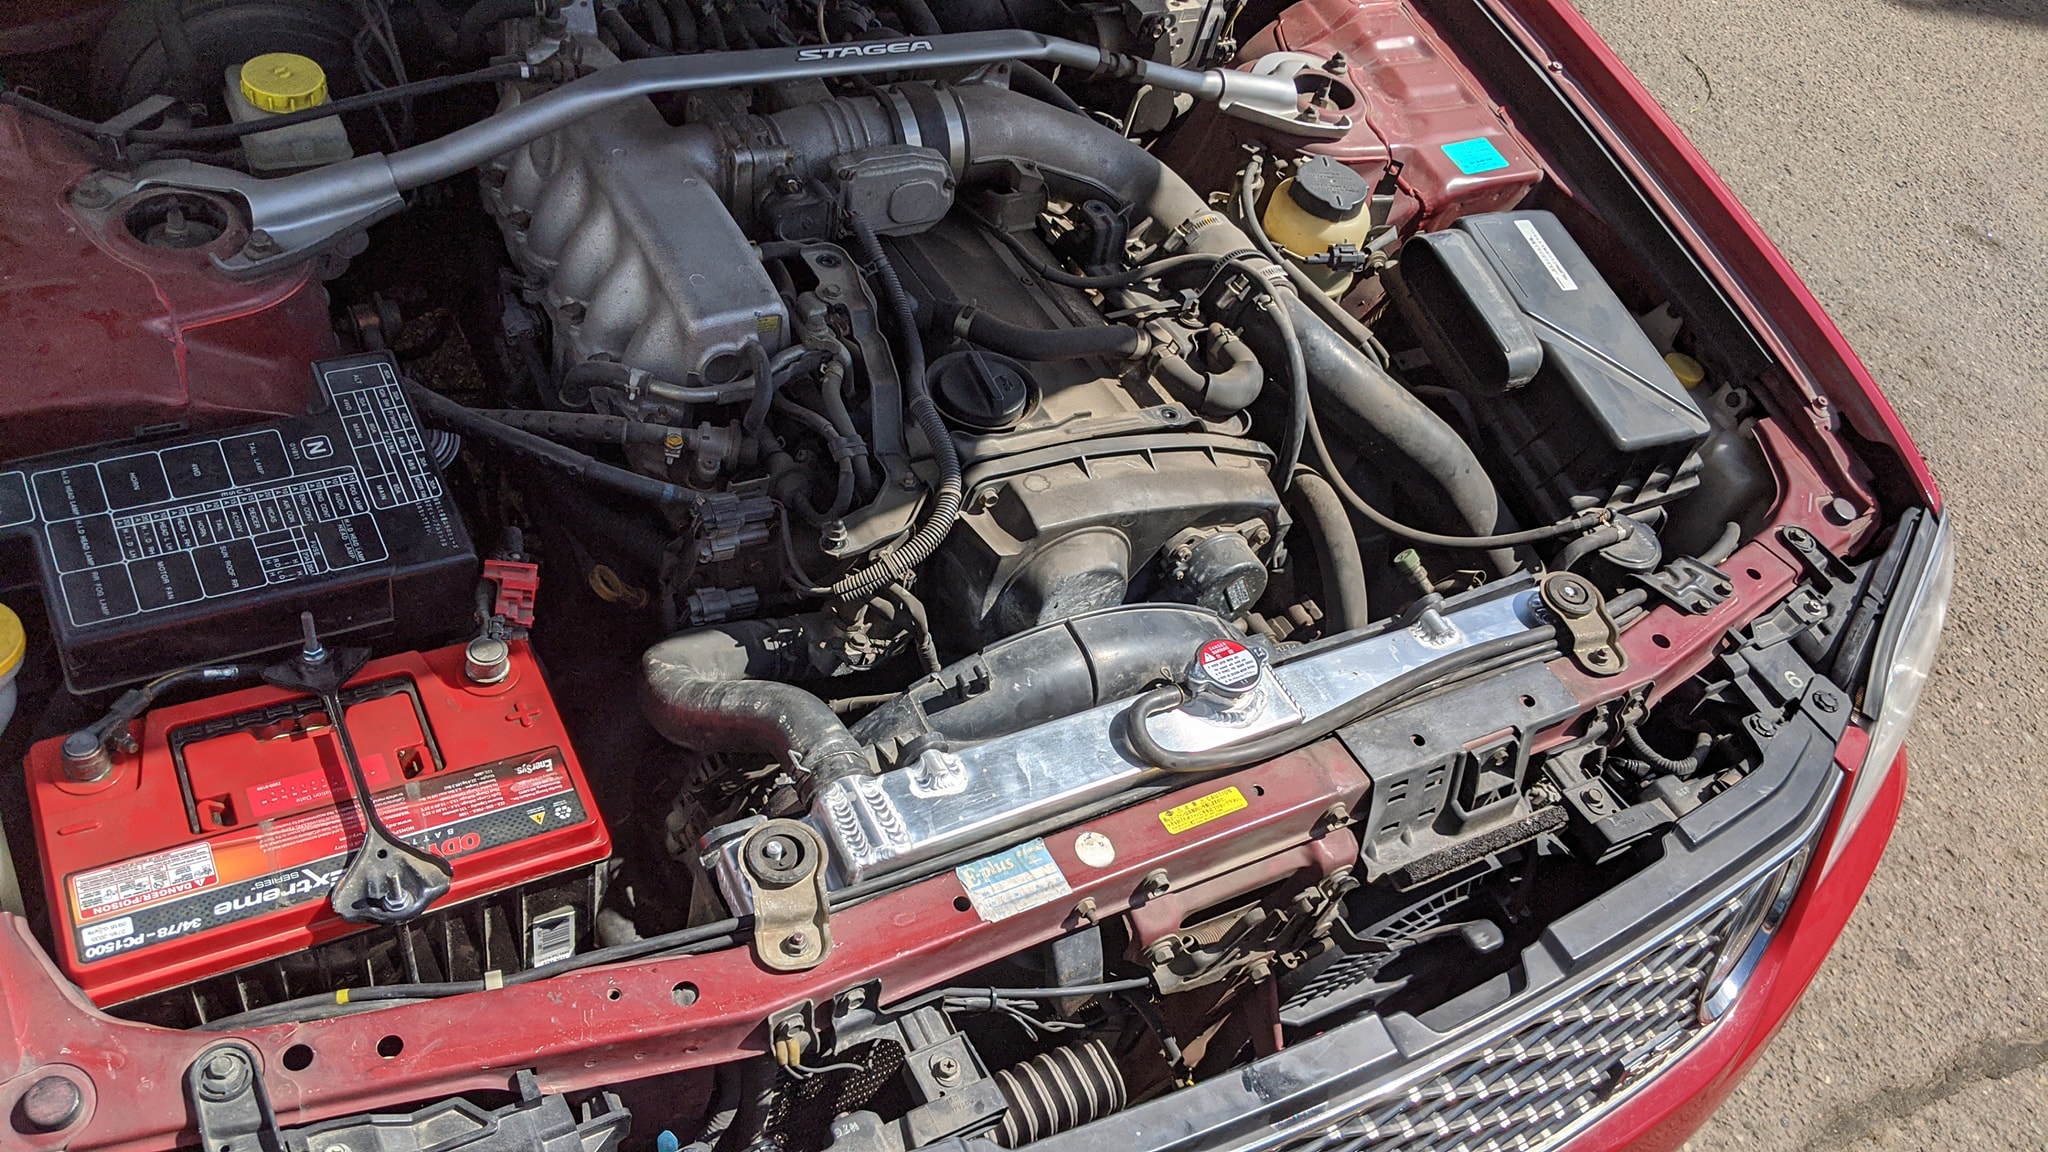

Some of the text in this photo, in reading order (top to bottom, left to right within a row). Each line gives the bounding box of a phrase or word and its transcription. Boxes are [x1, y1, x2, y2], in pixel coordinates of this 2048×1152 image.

[797, 39, 933, 63] STAGEA
[352, 373, 361, 384] ALT
[342, 398, 352, 411] 4WD
[352, 423, 362, 438] MAIN
[382, 430, 396, 454] F/LINK
[397, 436, 406, 447] ABS
[247, 442, 264, 475] TAIL LAMP
[406, 457, 416, 470] ABS
[190, 462, 201, 477] 4WD
[128, 472, 140, 490] HORN
[59, 470, 80, 515] H.I.D HEAD LAMP
[333, 491, 345, 510] AUDIO
[348, 483, 363, 511] FOG LAMP
[376, 484, 386, 500] MAIN
[282, 499, 295, 522] AIR CON
[298, 493, 313, 521] ENG CONT
[314, 490, 330, 518] ENG CONT
[230, 510, 243, 532] AC100V
[247, 506, 260, 528] DEICER
[266, 506, 277, 523] HICAS
[140, 524, 151, 543] H.I.D
[158, 521, 168, 536] HEAD
[176, 517, 186, 532] HEAD
[196, 519, 207, 537] HORN
[214, 518, 224, 531] TAIL
[74, 520, 94, 566] H.I.D HEAD LAMP
[121, 528, 133, 547] H.I.D
[337, 523, 355, 559] HEAD LAMP
[344, 518, 365, 561] H.I.D HEAD LAMP
[309, 540, 319, 556] FUSE
[218, 545, 239, 588] SUN ROOF RR
[156, 560, 174, 599] MOTOR FAN
[90, 571, 109, 615] RR FOG LAMP
[1783, 670, 1804, 688] 6
[295, 794, 311, 803] Date
[93, 882, 192, 915] DANGER/POISON
